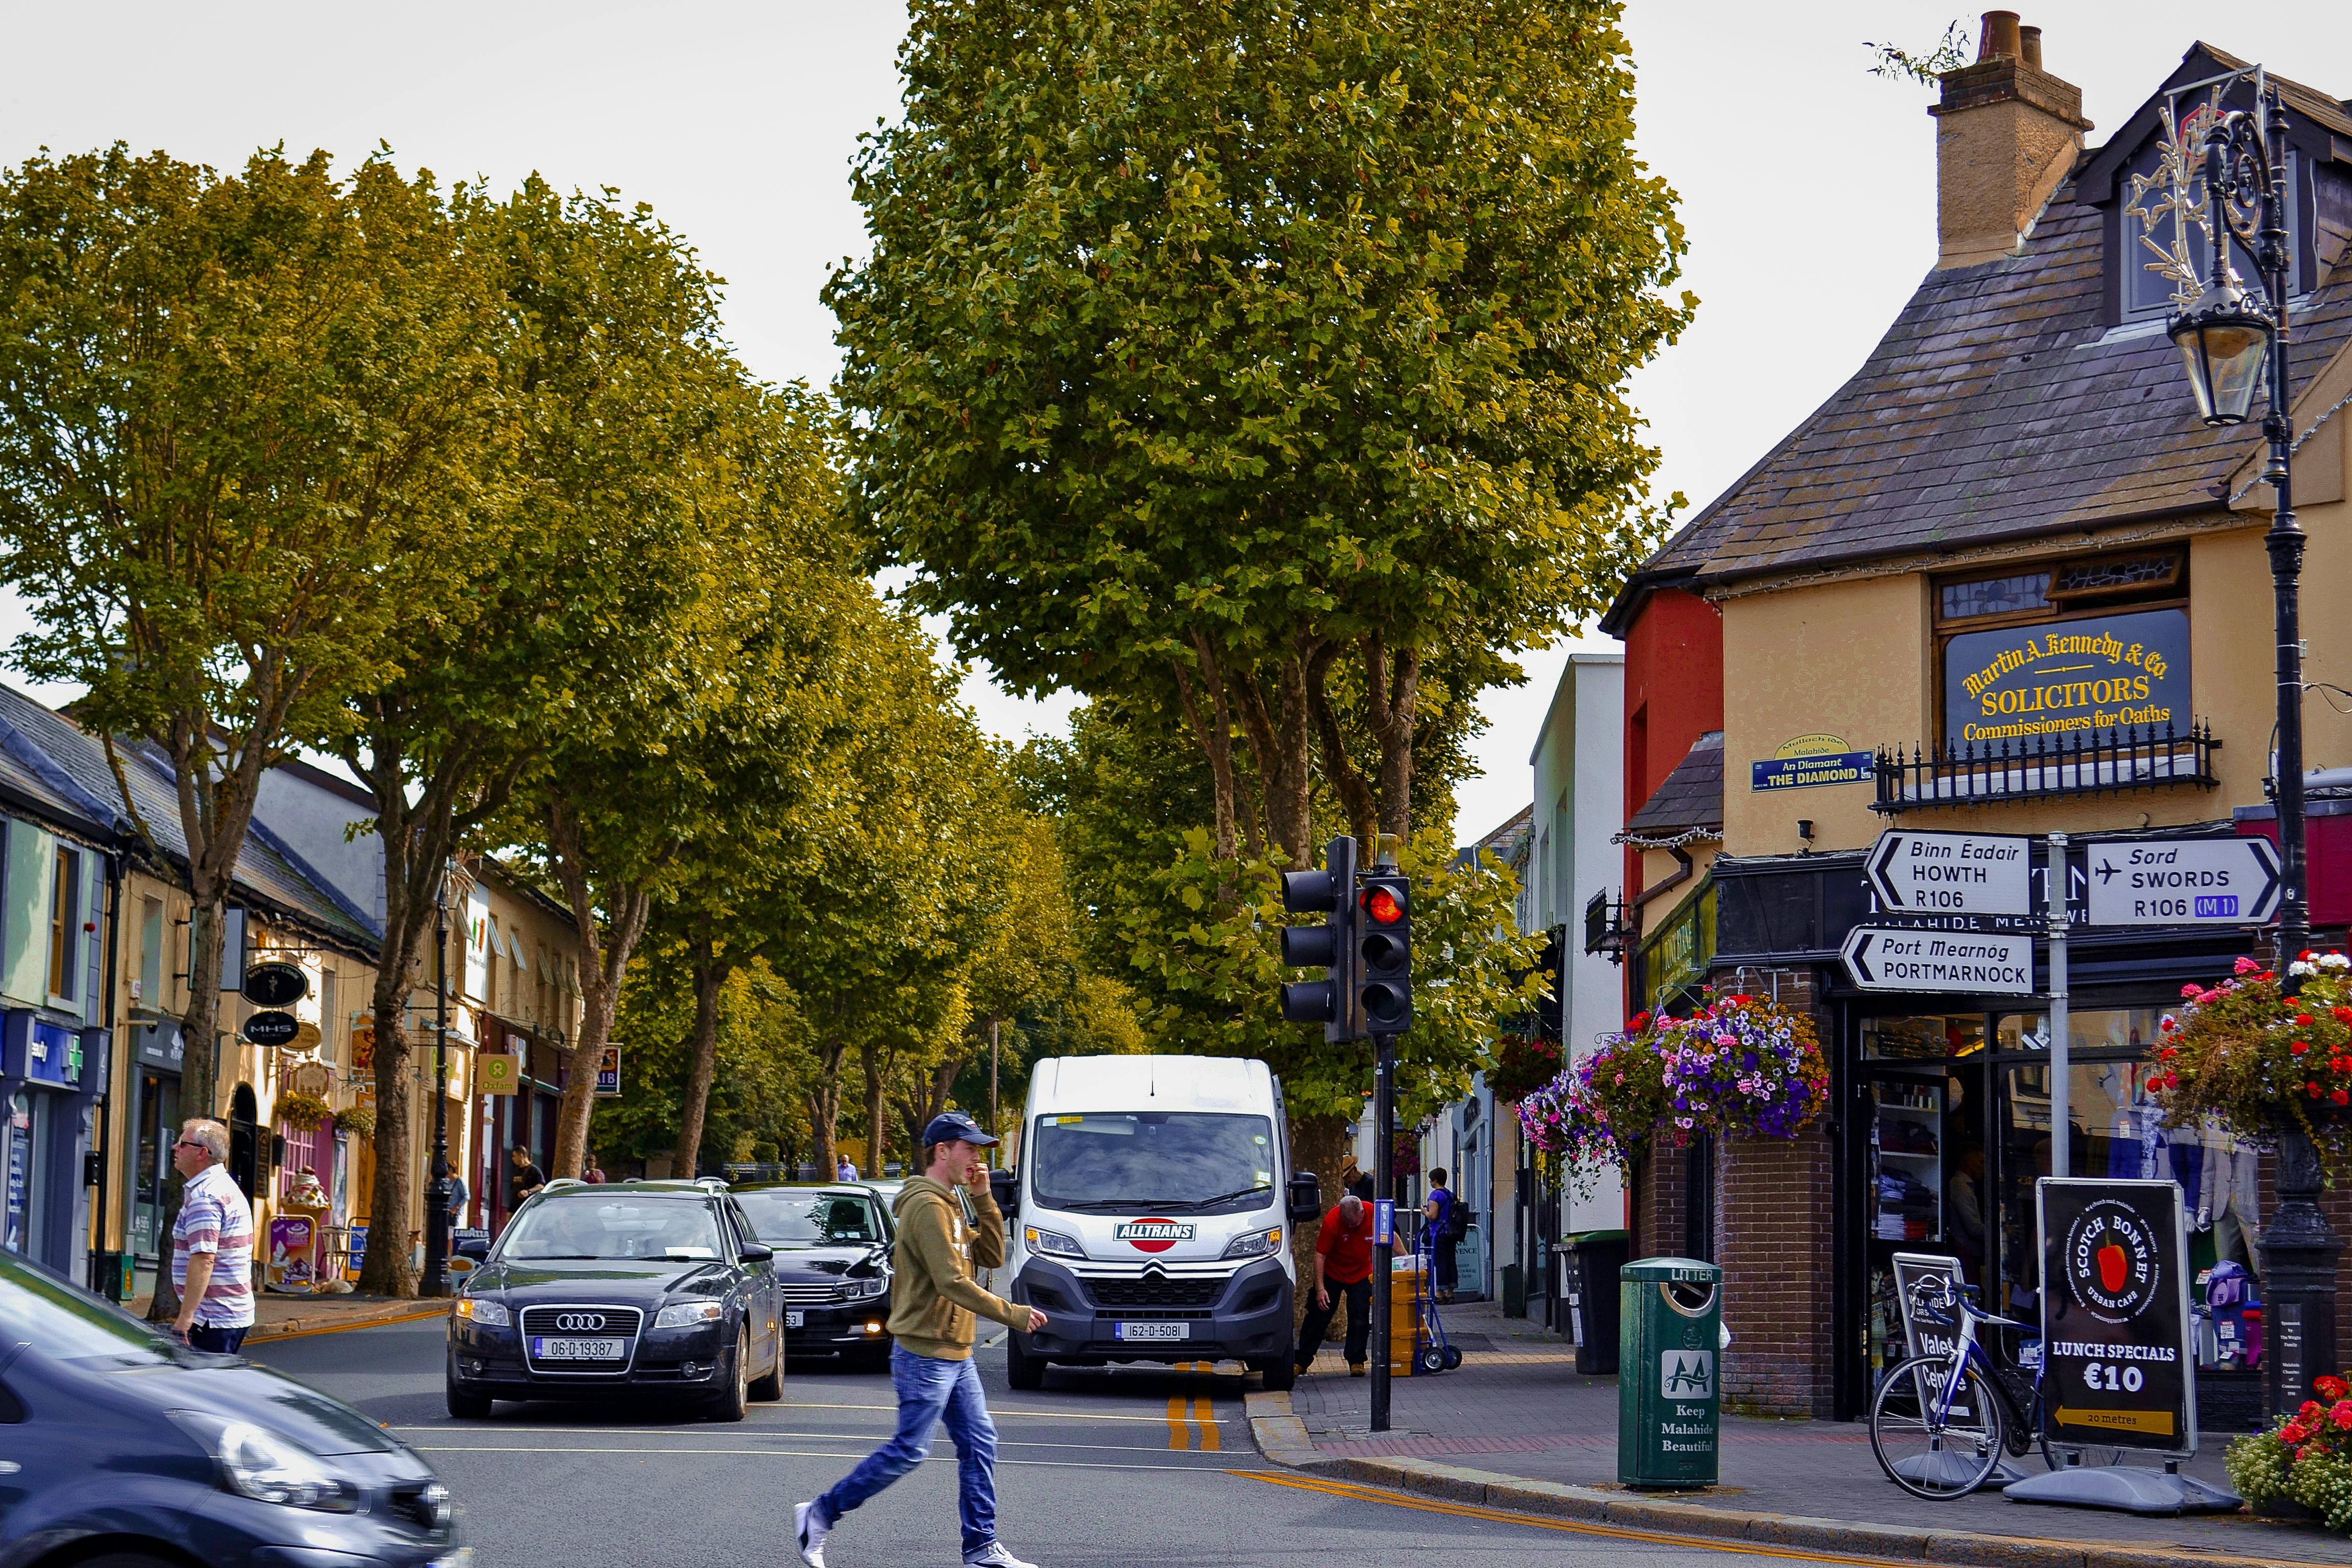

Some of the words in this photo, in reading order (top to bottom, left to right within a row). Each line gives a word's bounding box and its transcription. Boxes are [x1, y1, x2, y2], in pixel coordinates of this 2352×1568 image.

[1962, 647, 2025, 699] Martin
[2026, 640, 2046, 662] A.
[2046, 631, 2124, 665] Kennedy
[2124, 642, 2145, 666] &
[1981, 675, 2150, 717] SOLICITORS
[1963, 715, 2092, 742] Commissioners
[2093, 709, 2118, 728] for
[2119, 704, 2170, 725] Oaths
[1794, 747, 1829, 756] Malahide
[1782, 763, 1796, 771] An
[1798, 758, 1842, 770] Diamant
[1768, 774, 1794, 787] THE
[1797, 768, 1858, 785] DIAMOND
[1910, 841, 1951, 858] Binn
[1961, 840, 2019, 861] Éadair
[2128, 847, 2178, 865] Sord
[1913, 865, 1987, 884] HOWTH
[2130, 870, 2230, 889] SWORDS
[1916, 890, 1964, 908] R106
[2134, 899, 2187, 917] R106
[1882, 938, 1921, 955] Port
[1929, 940, 2009, 962] Mearnóg
[1884, 962, 2026, 984] PORTMARNOCK
[250, 1025, 292, 1033] MHS
[482, 1081, 512, 1089] Oxfam
[1119, 1225, 1192, 1238] ALLTRANS
[2077, 1217, 2106, 1279] SCOTCH
[2113, 1215, 2147, 1283] BONNET
[1672, 1268, 1712, 1281] LITTER
[2087, 1286, 2115, 1308] URBAN
[2117, 1290, 2138, 1307] CAFE
[1130, 1326, 1180, 1336] 162-D-5081
[2052, 1342, 2104, 1358] LUNCH
[2107, 1344, 2175, 1361] SPECIALS
[1922, 1364, 1967, 1391] Cene
[2084, 1363, 2143, 1392] €10
[1676, 1405, 1705, 1417] Keep
[2087, 1412, 2099, 1422] 20
[2101, 1414, 2137, 1425] metres
[1661, 1423, 1713, 1435] Malahide
[1662, 1440, 1712, 1452] Beautiful
